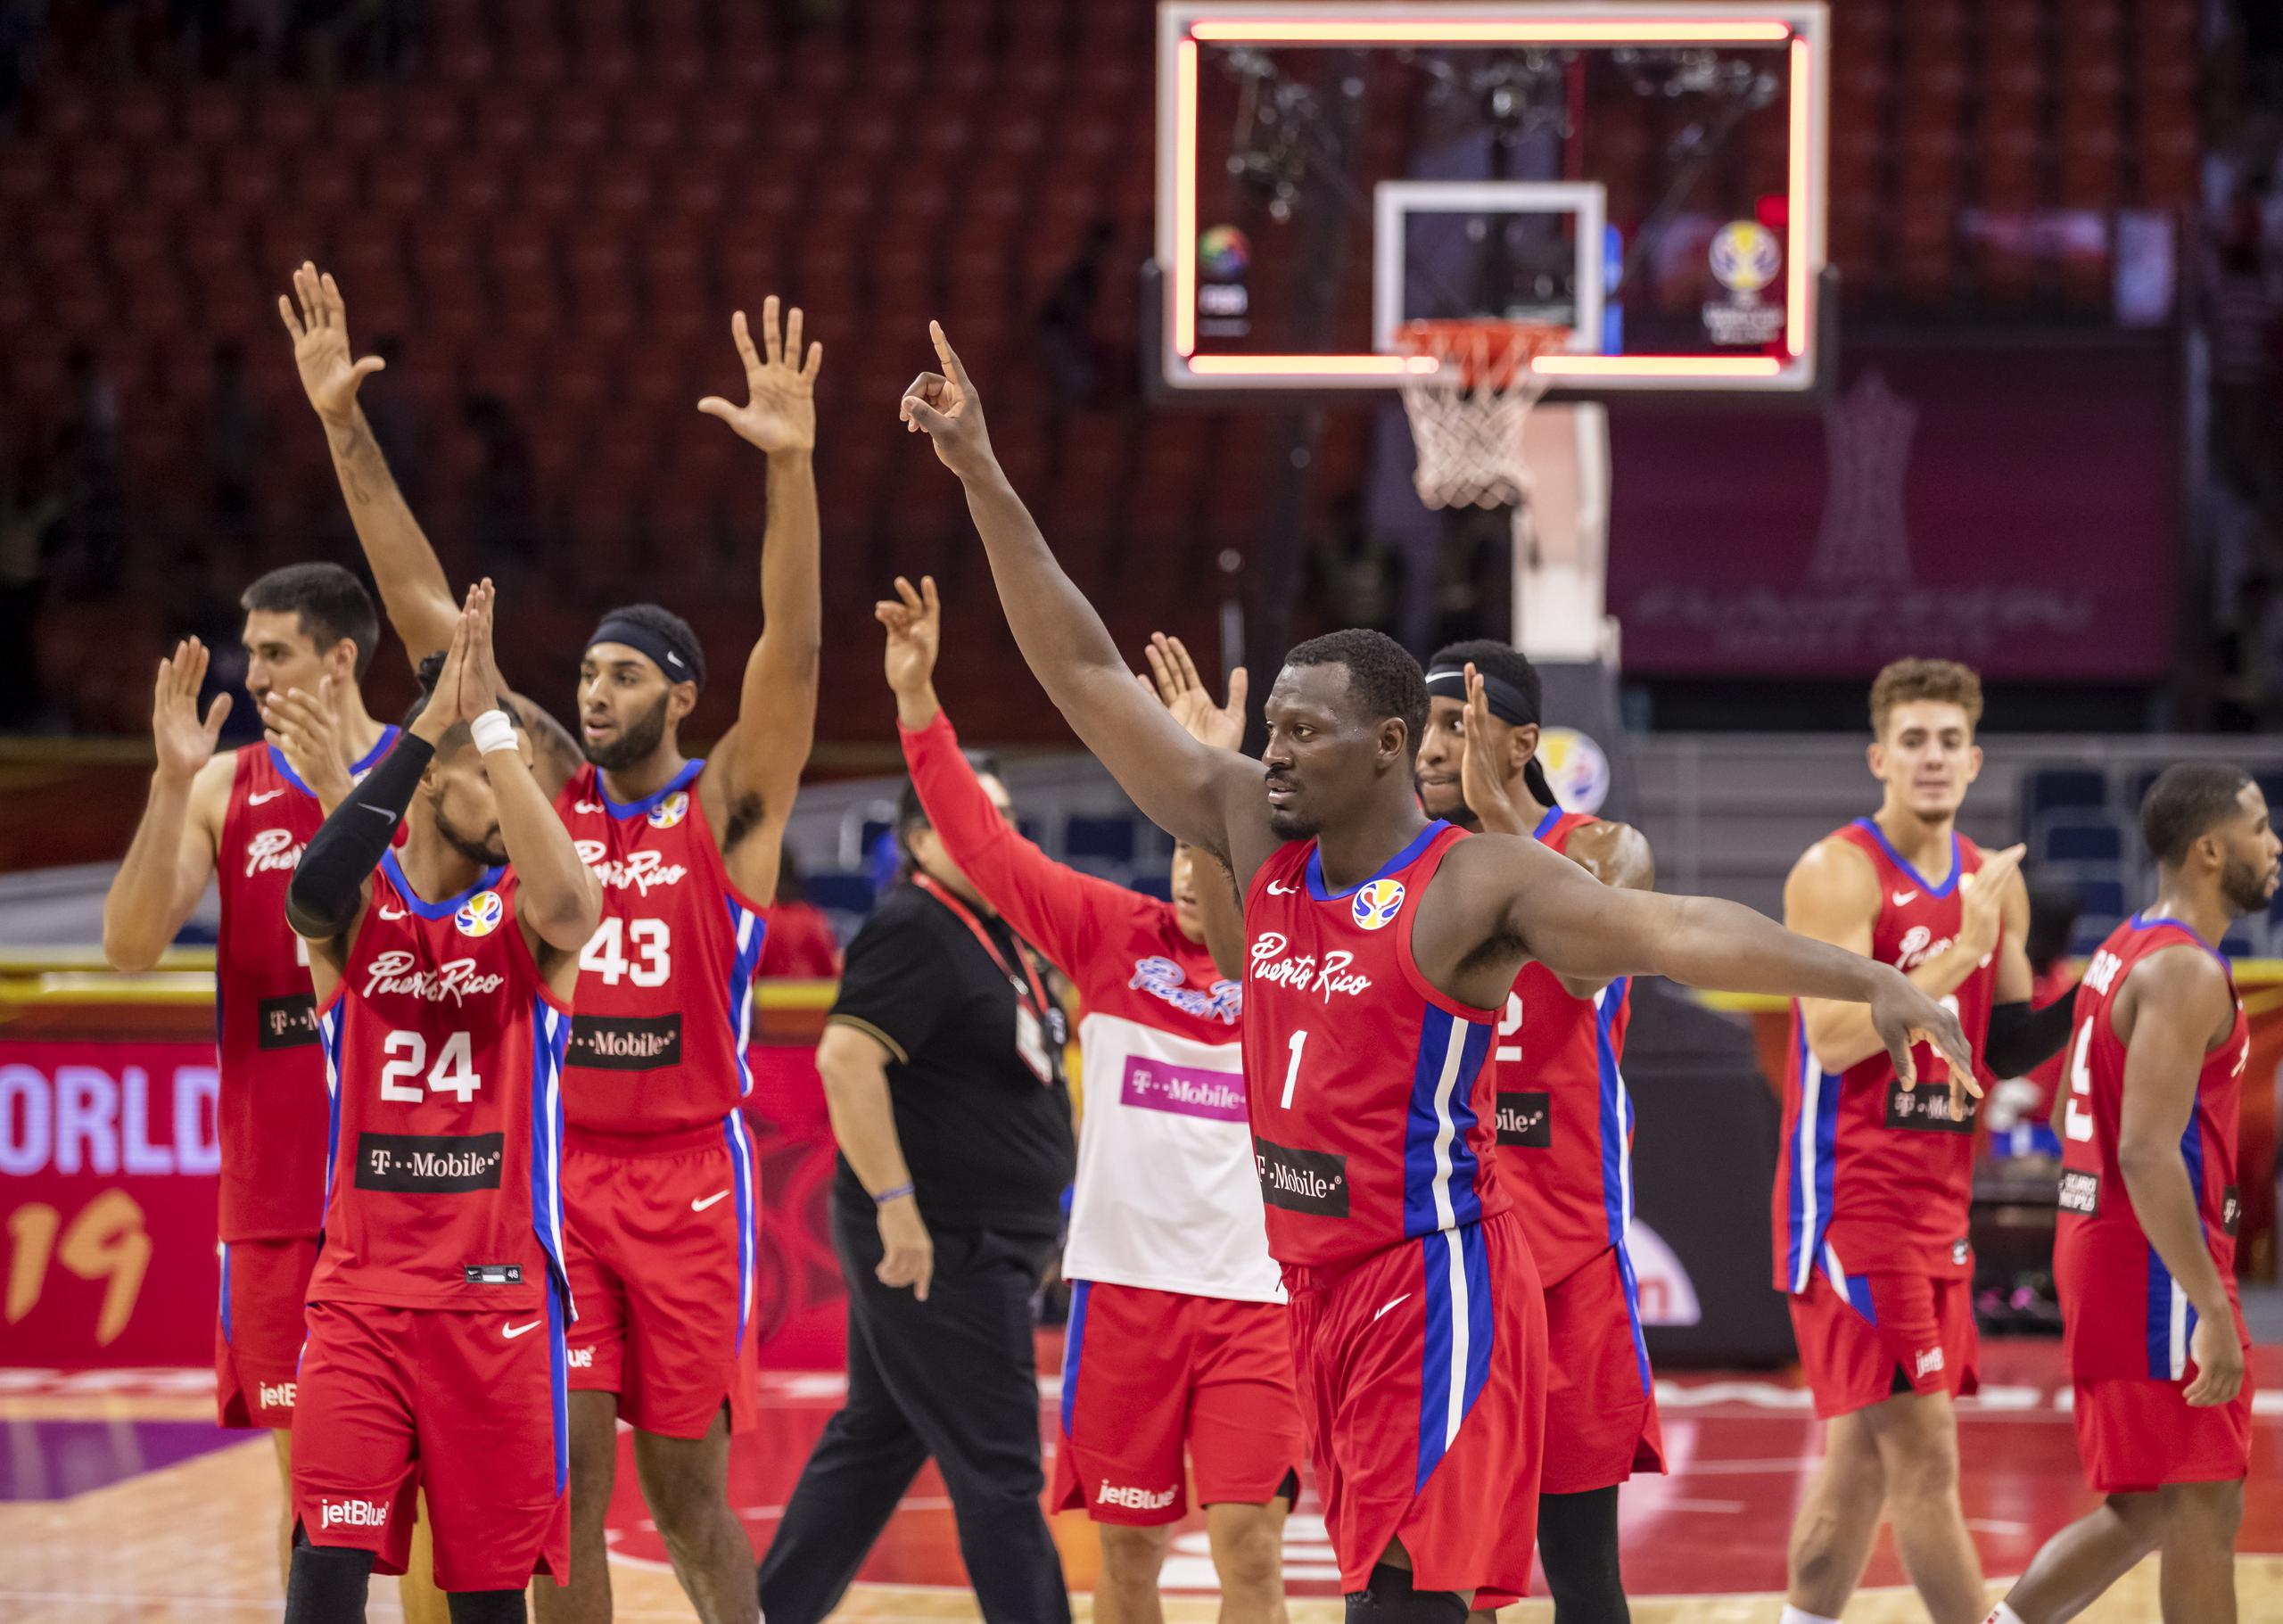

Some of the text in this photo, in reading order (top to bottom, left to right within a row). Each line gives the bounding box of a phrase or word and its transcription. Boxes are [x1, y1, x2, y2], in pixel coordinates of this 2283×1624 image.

[624, 850, 688, 897] Rico
[362, 950, 439, 1002] Puerto
[437, 957, 505, 1009] Rico
[579, 917, 671, 987] 43
[1250, 932, 1372, 1004] Puerto Rico
[381, 1029, 482, 1104] 24
[1281, 1029, 1308, 1110] 1
[0, 1063, 221, 1177] ORLD
[4, 1187, 153, 1348] 19
[321, 1498, 390, 1529] jetBlue
[1095, 1478, 1175, 1510] jetBlue
